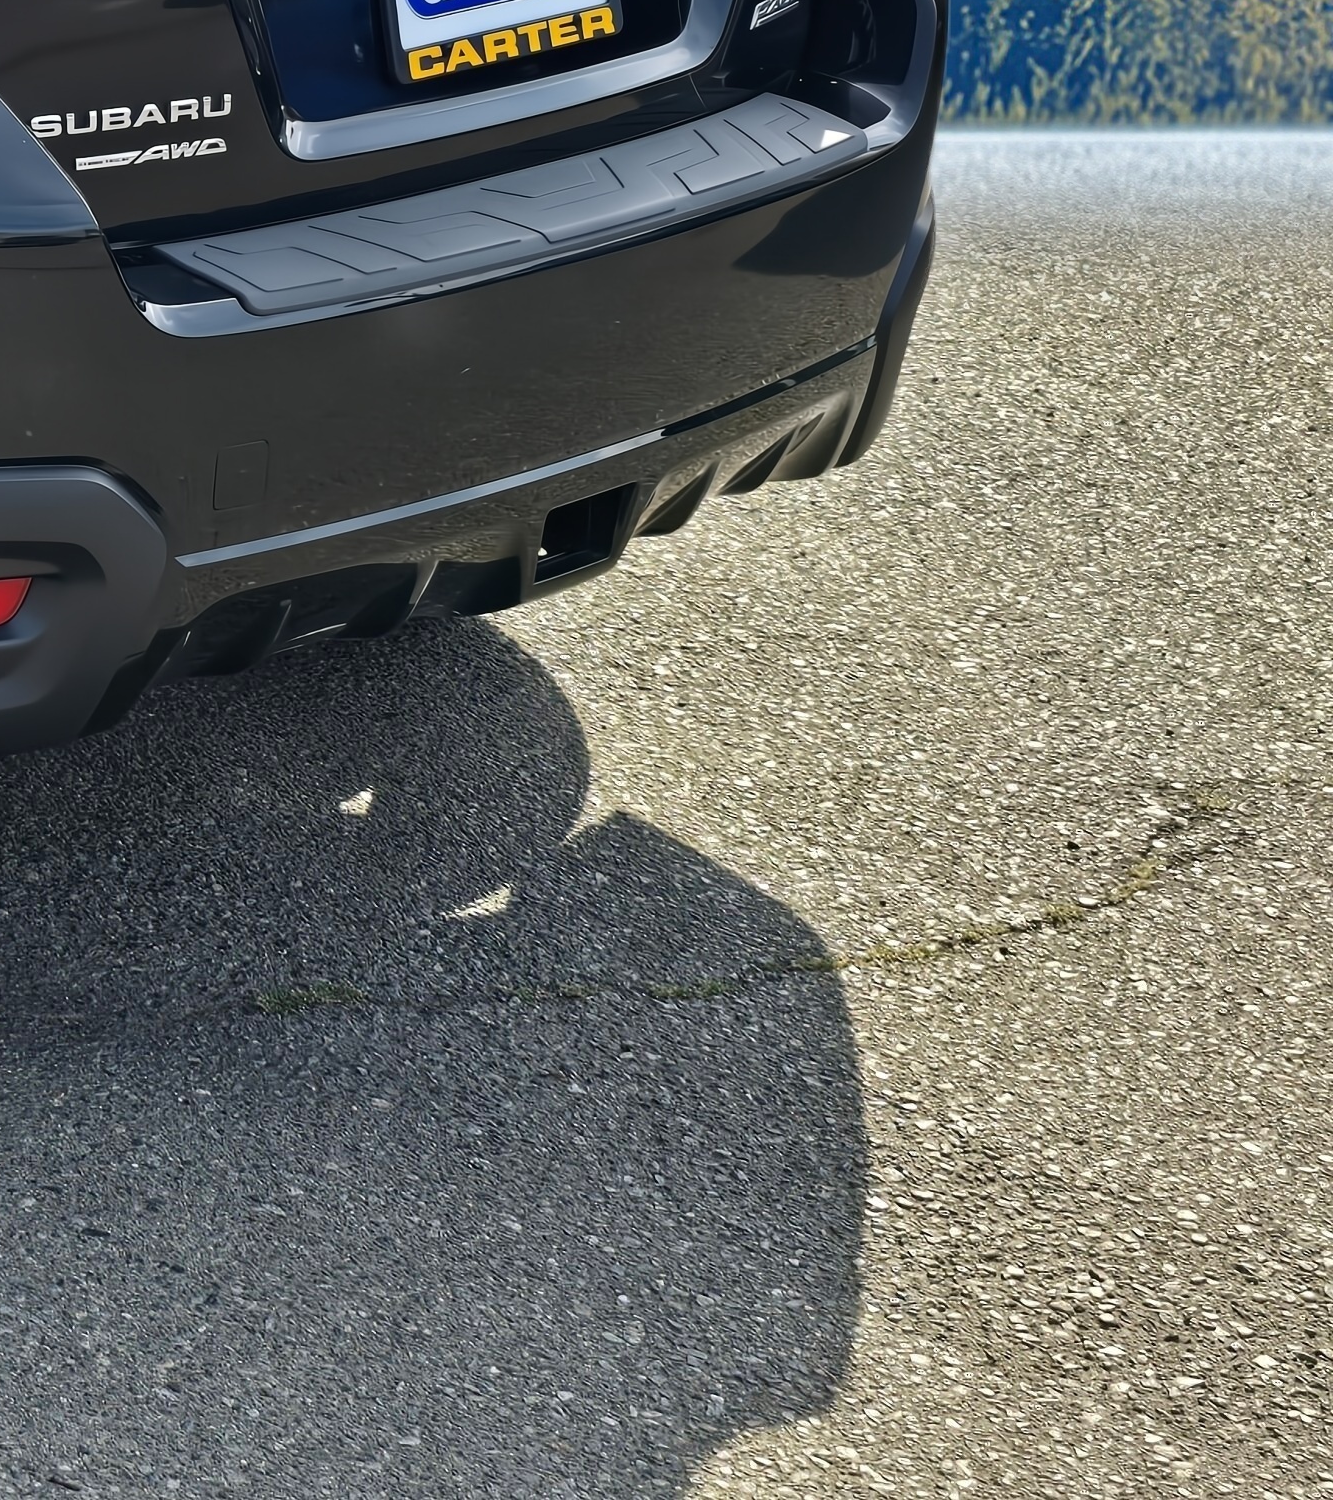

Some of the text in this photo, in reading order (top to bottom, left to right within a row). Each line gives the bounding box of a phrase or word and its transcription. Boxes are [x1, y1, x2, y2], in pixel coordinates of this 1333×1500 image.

[408, 6, 616, 80] CARTER
[30, 93, 232, 138] SUBARU
[133, 138, 227, 164] AWD
